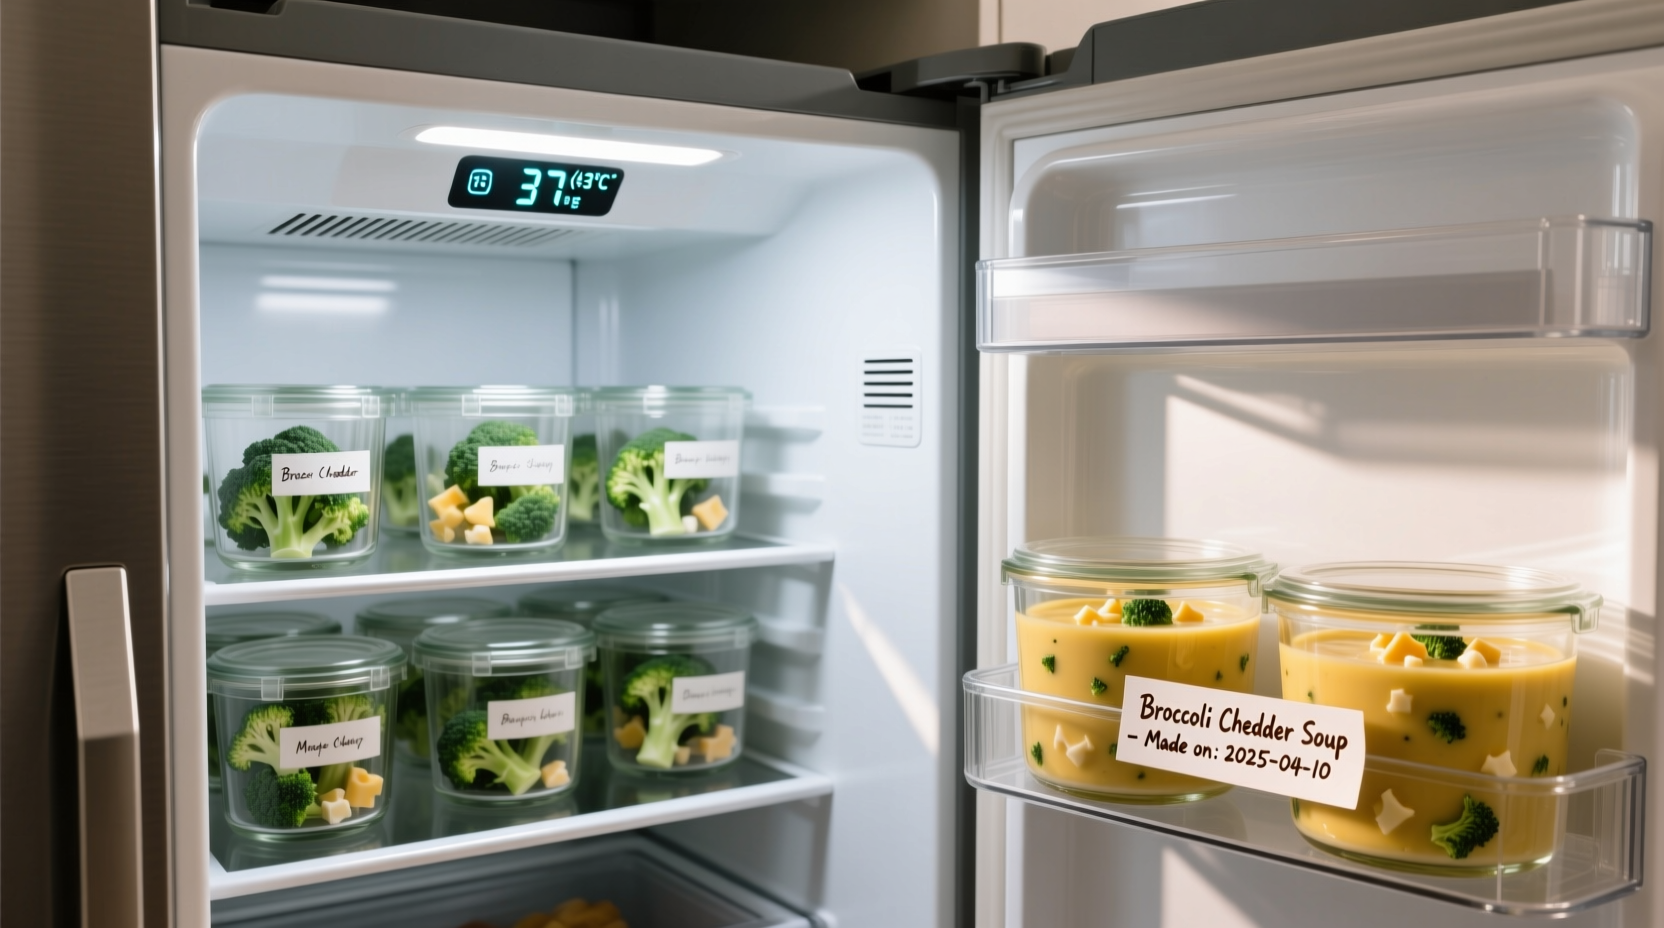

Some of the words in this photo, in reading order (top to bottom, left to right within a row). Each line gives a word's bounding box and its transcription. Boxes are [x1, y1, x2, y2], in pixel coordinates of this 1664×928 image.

[515, 167, 567, 206] 37
[1140, 693, 1213, 729] Broccoli
[1218, 707, 1295, 742] Chedder
[1301, 720, 1348, 761] Soup
[1144, 729, 1188, 754] Made
[1193, 743, 1219, 760] on:
[1224, 744, 1331, 780] 2025-04-10
